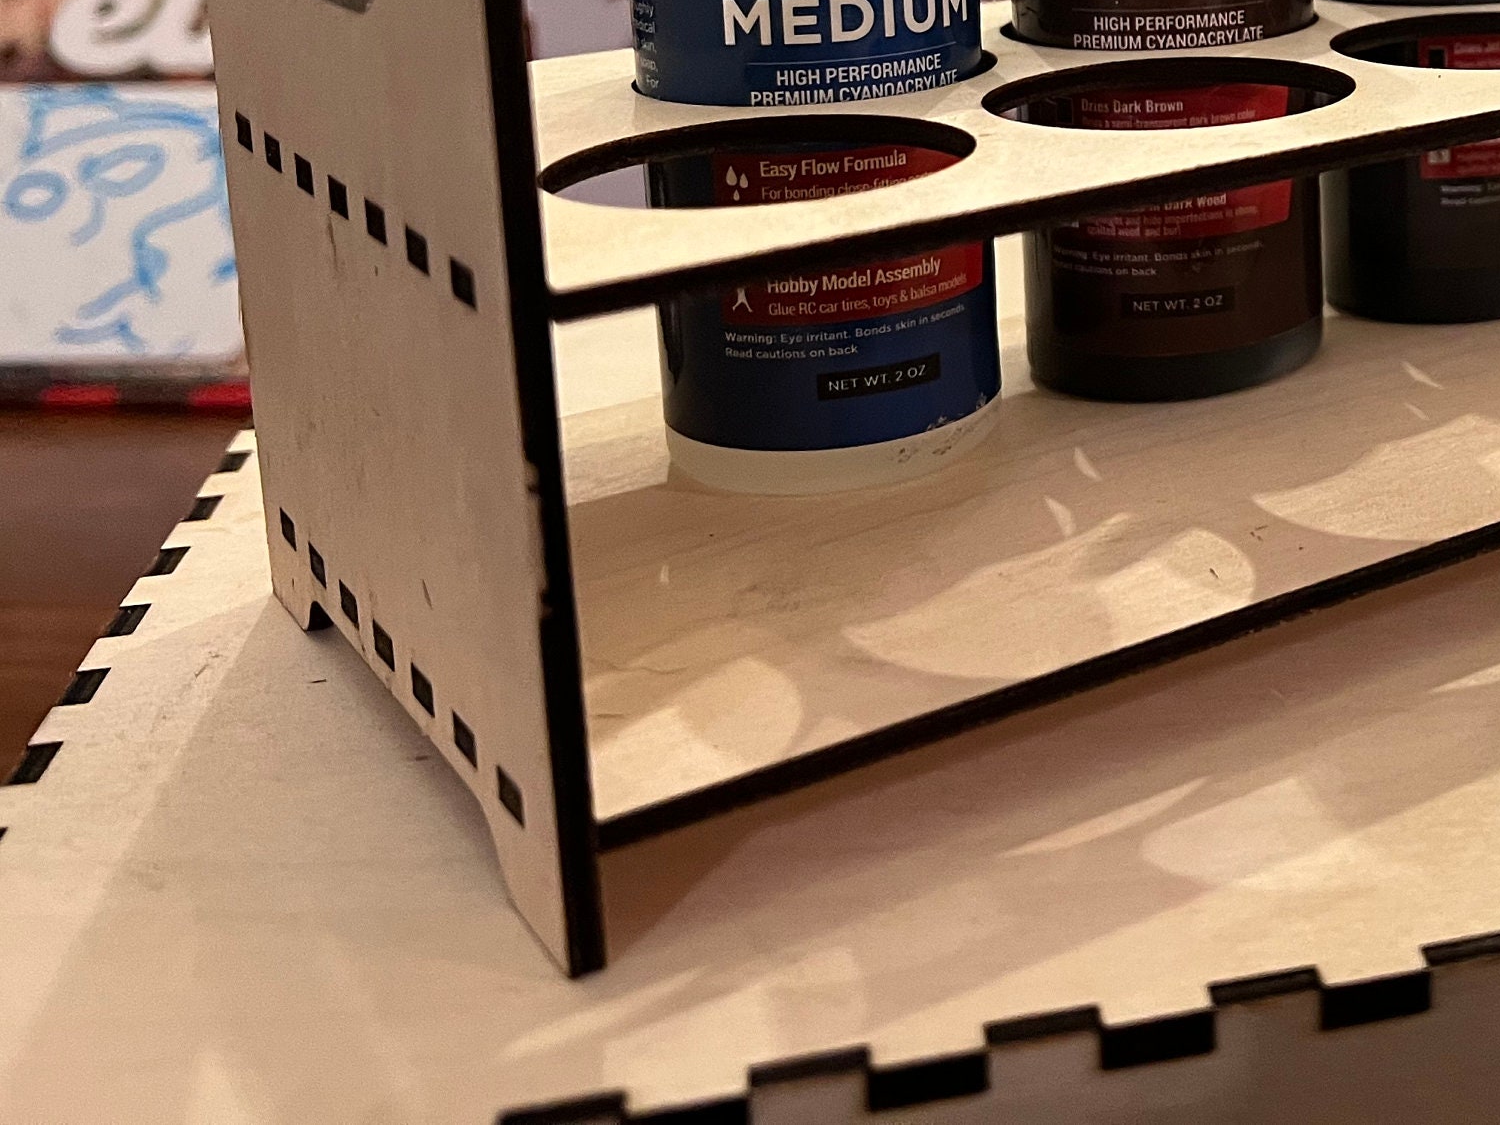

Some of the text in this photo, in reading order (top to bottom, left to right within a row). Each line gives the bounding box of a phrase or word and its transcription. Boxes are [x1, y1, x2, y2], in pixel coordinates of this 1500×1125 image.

[1094, 10, 1246, 32] HIGH PERFORMANCE
[1073, 25, 1264, 50] PREMIUM CYANOACRYLATE
[776, 53, 942, 87] HIGH PERFORMANCE
[751, 68, 958, 106] PREMIUM CYANOACRYLATE
[1113, 98, 1141, 114] Dark
[1145, 99, 1184, 113] Brown
[760, 148, 907, 181] Easy Flow Formula
[761, 186, 781, 201] For
[767, 256, 941, 296] Hobby Model Assembly
[768, 271, 967, 317] Glue RC car tires, toys & balsa models
[1133, 300, 1160, 312] NET
[1164, 298, 1189, 312] WT.
[1205, 294, 1223, 308] OZ
[725, 331, 777, 346] Warning:
[780, 333, 803, 346] Eye
[855, 323, 891, 338] Bonds
[895, 317, 917, 332] skin
[919, 314, 928, 327] in
[725, 344, 858, 360] Read cautions on back
[829, 364, 926, 393] NET WT. 2 OZ
